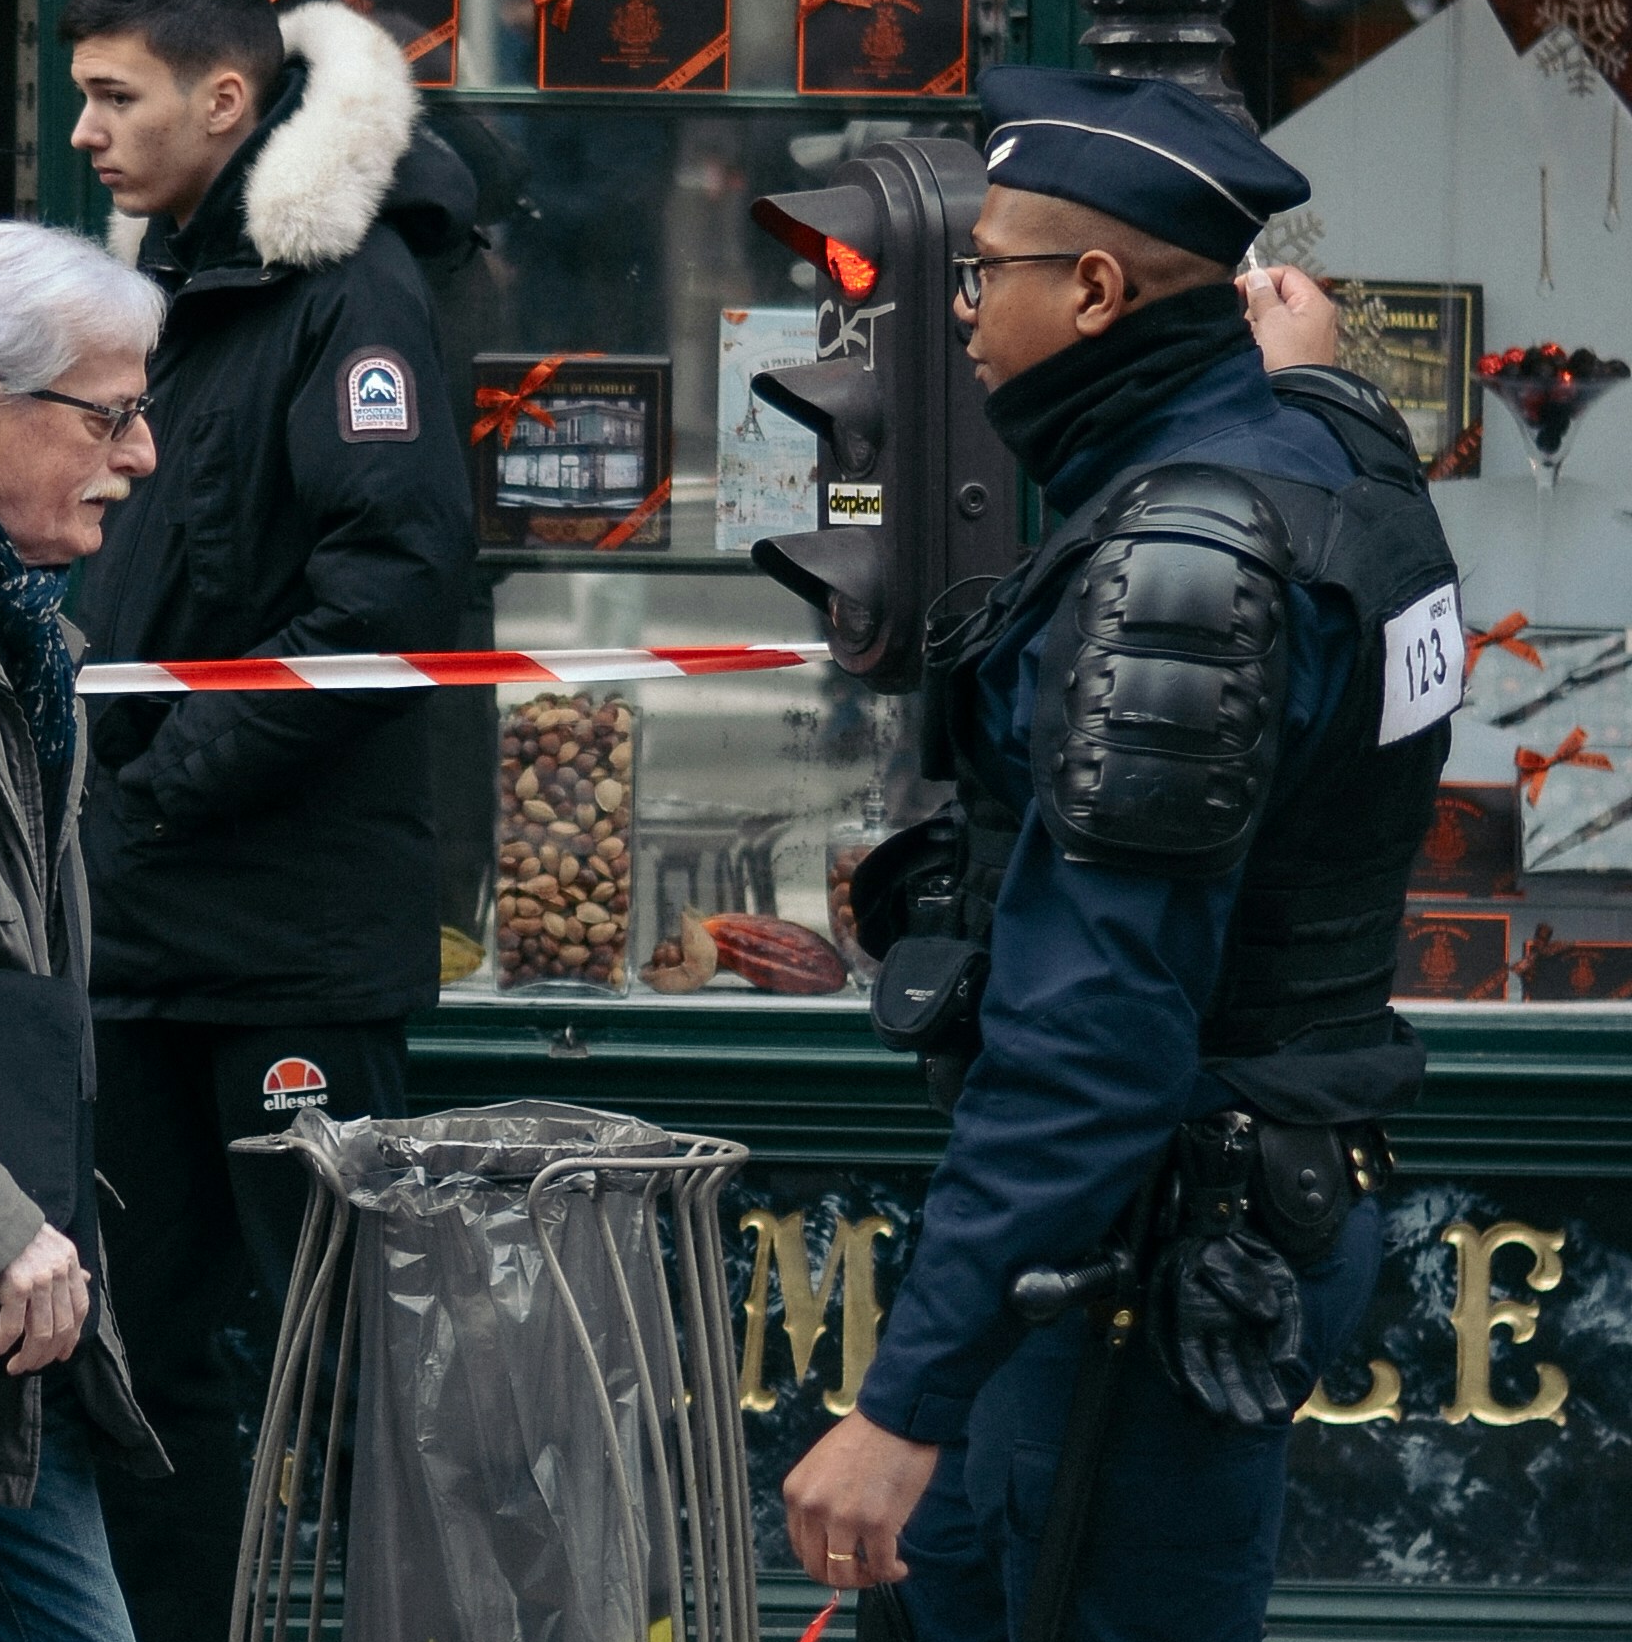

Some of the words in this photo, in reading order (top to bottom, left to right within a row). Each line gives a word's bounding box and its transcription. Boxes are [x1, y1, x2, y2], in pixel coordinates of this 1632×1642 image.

[354, 407, 403, 415] MOUNTAIN
[829, 488, 881, 520] derpland
[1405, 628, 1447, 703] 123
[263, 1093, 328, 1111] ellesse
